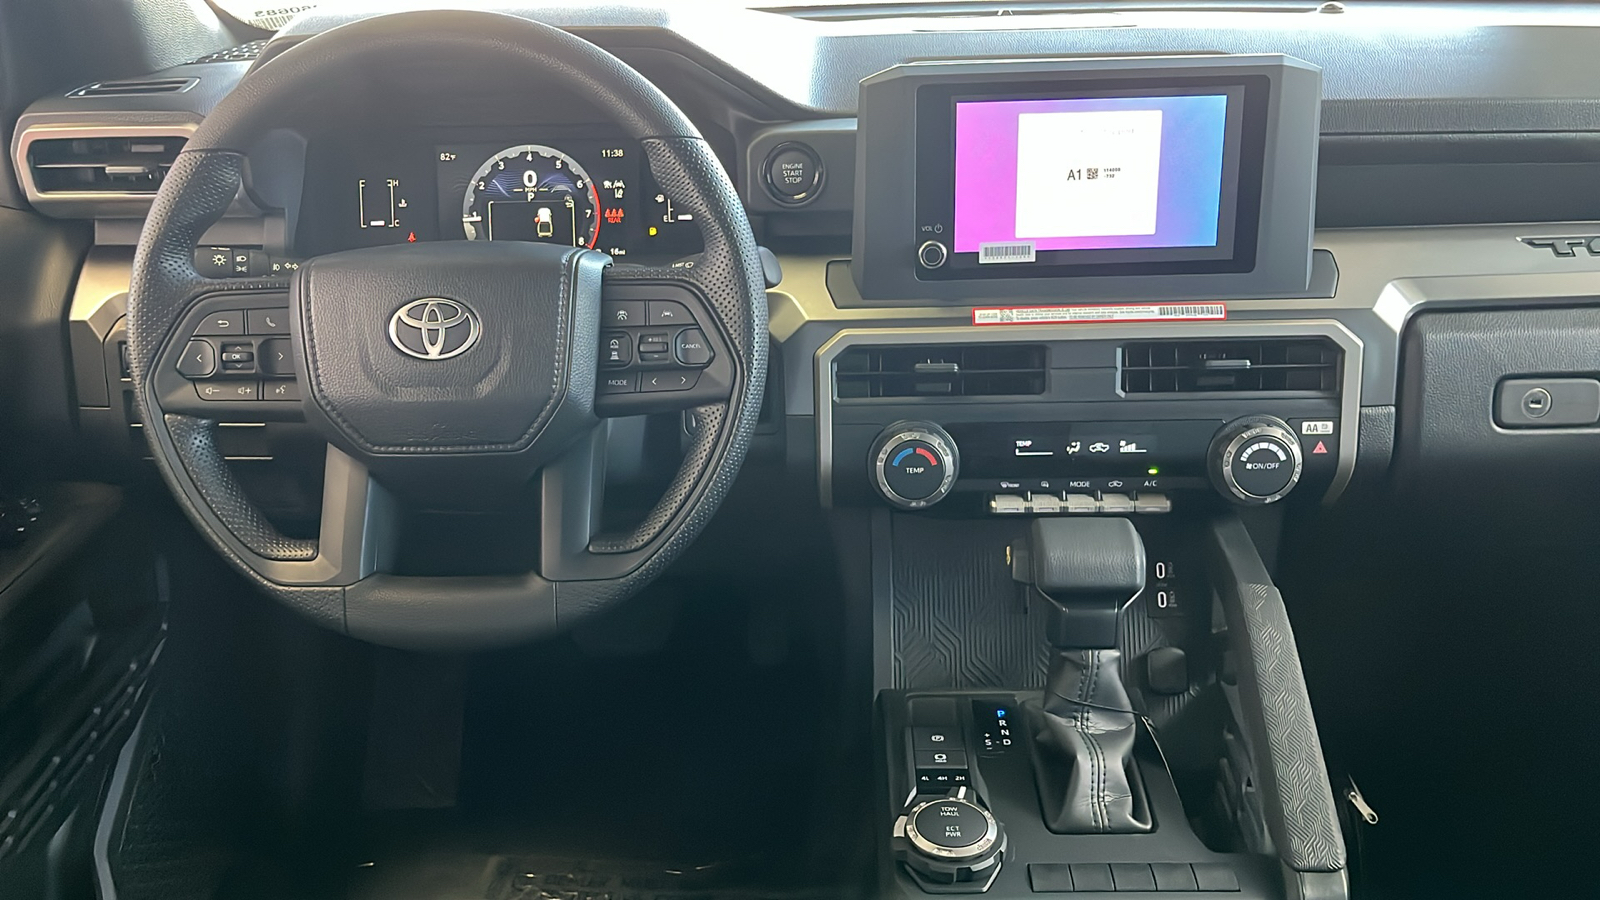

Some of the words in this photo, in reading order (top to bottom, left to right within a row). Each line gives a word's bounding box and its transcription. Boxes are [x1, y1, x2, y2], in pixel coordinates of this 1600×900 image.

[526, 153, 533, 161] 4
[602, 149, 624, 157] 11:38
[498, 162, 505, 170] 3
[555, 161, 562, 169] 5
[523, 169, 537, 187] 0
[1066, 169, 1082, 181] A1
[478, 182, 485, 190] 2
[576, 180, 584, 188] 6
[527, 193, 535, 202] P
[585, 209, 592, 218] 7
[578, 237, 585, 246] 8
[1305, 423, 1319, 433] AA
[1252, 462, 1280, 470] ON/OFF
